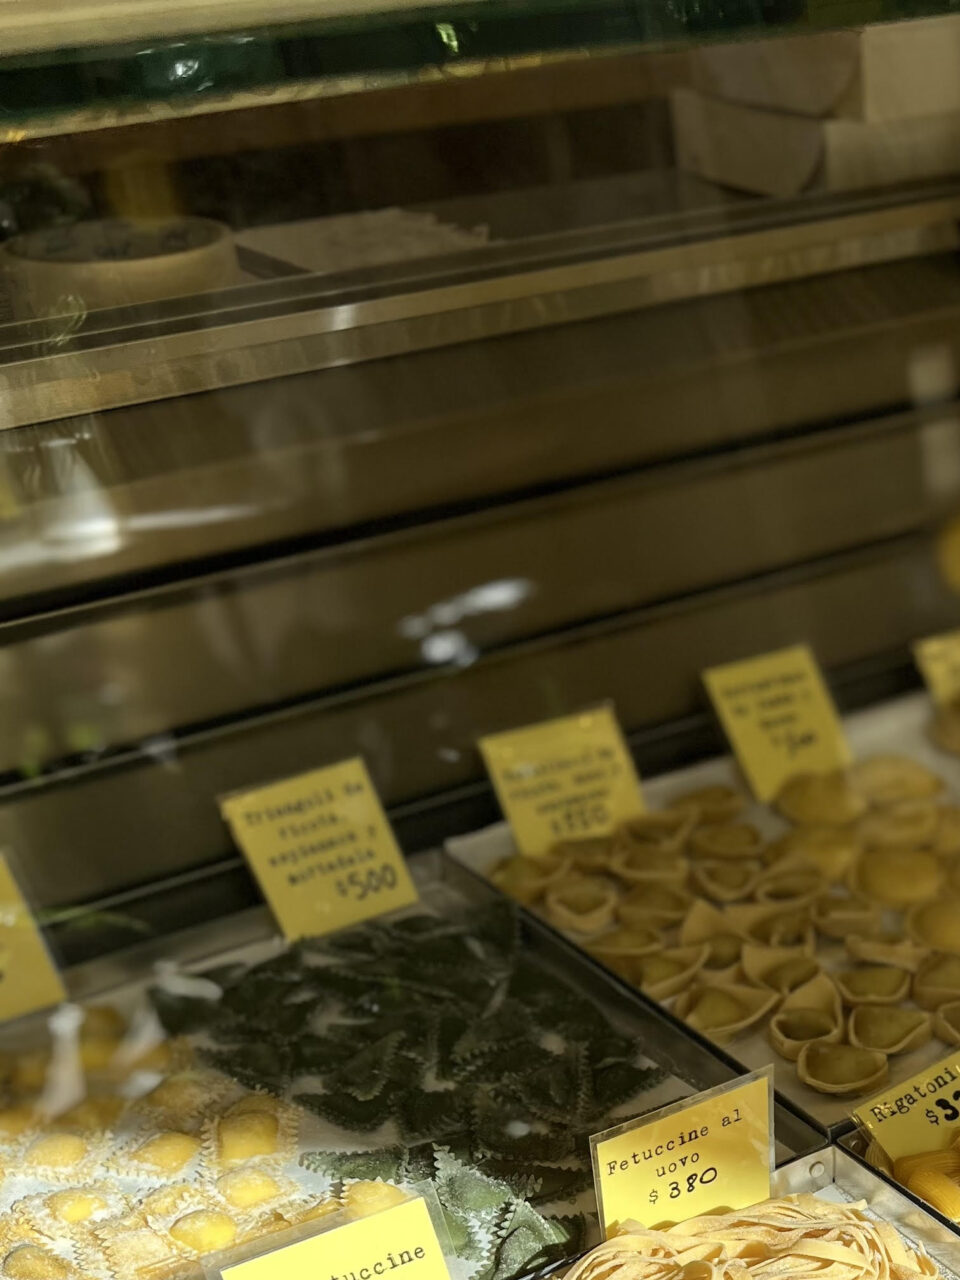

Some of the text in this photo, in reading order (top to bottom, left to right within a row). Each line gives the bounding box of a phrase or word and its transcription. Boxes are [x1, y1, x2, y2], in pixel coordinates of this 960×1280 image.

[869, 1067, 958, 1123] Rigatoni
[607, 1108, 743, 1176] Fetuccine al
[655, 1152, 700, 1178] uovo
